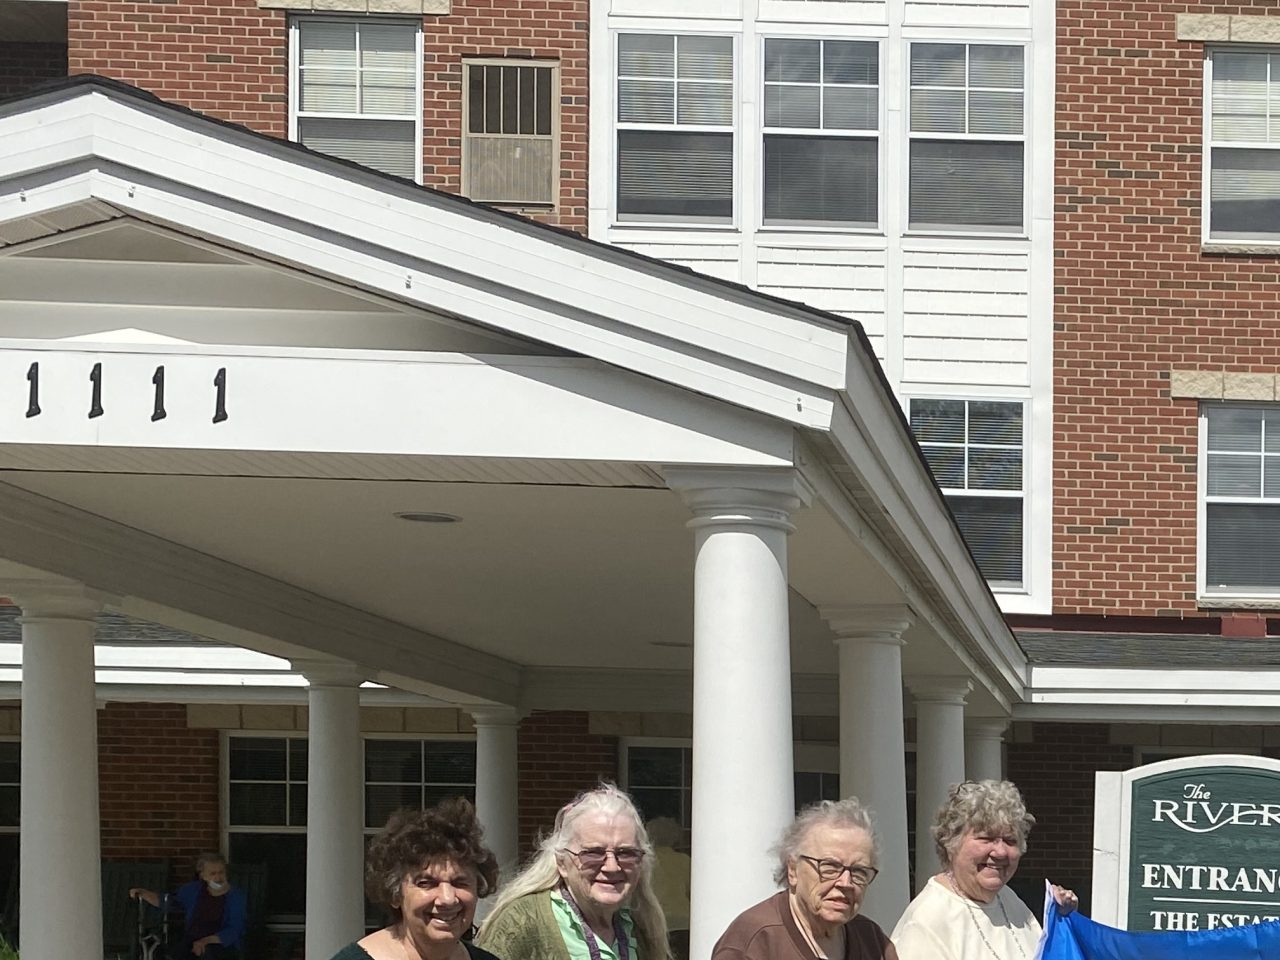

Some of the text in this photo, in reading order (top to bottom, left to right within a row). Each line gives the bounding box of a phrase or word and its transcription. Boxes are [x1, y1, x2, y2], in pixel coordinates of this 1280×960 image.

[26, 362, 228, 424] 1111
[1183, 784, 1211, 800] The
[1150, 911, 1199, 931] THE
